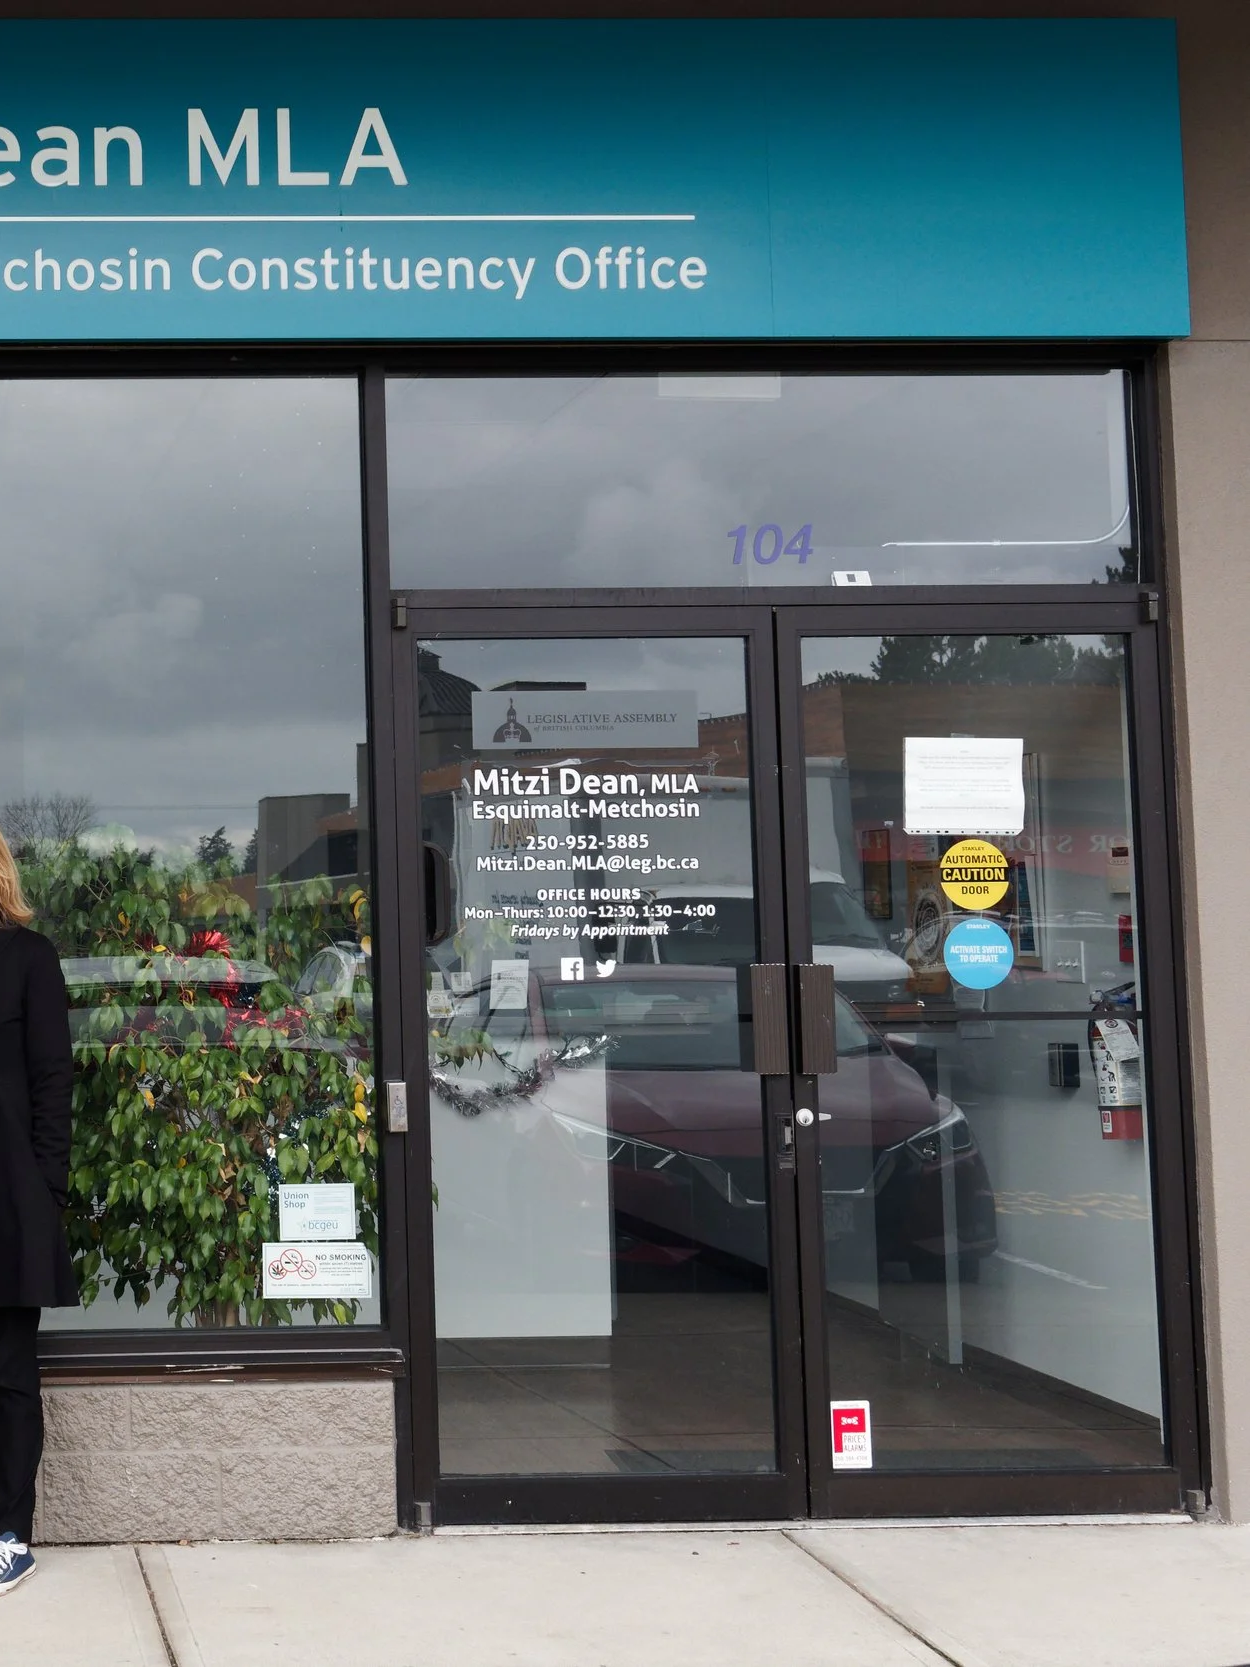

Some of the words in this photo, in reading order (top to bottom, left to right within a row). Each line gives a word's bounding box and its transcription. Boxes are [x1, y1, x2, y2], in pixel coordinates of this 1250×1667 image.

[187, 106, 409, 187] MLA
[191, 245, 536, 301] Constituency
[554, 245, 708, 291] Office
[727, 523, 814, 565] 104
[527, 713, 610, 724] LEGISLATIVE
[614, 713, 678, 723] ASSEMBLY
[473, 768, 550, 796] Mitzi
[559, 768, 646, 798] Dean,
[650, 773, 700, 795] MLA
[472, 799, 701, 825] Esquimalt-Metchosin
[526, 834, 650, 851] 250-952-5885
[476, 855, 700, 874] Mitzi.Dean.MLA@leg.bc.ca
[945, 854, 1003, 864] AUTOMATIC
[942, 868, 1005, 881] CAUTION
[537, 888, 586, 901] OFFICE
[590, 887, 642, 900] HOURS
[961, 885, 990, 895] DOOR
[510, 924, 560, 940] Fridays
[562, 924, 580, 940] by
[581, 923, 670, 940] Appointment
[950, 945, 980, 954] ACTIVATE
[982, 945, 1008, 954] SWITCH
[959, 954, 968, 963] TO
[969, 954, 999, 963] OPERATE
[283, 1191, 309, 1200] Union
[283, 1200, 306, 1210] Shop
[308, 1219, 339, 1231] bcgeu
[329, 1253, 367, 1261] SMOKING
[843, 1434, 867, 1443] PRICE'S
